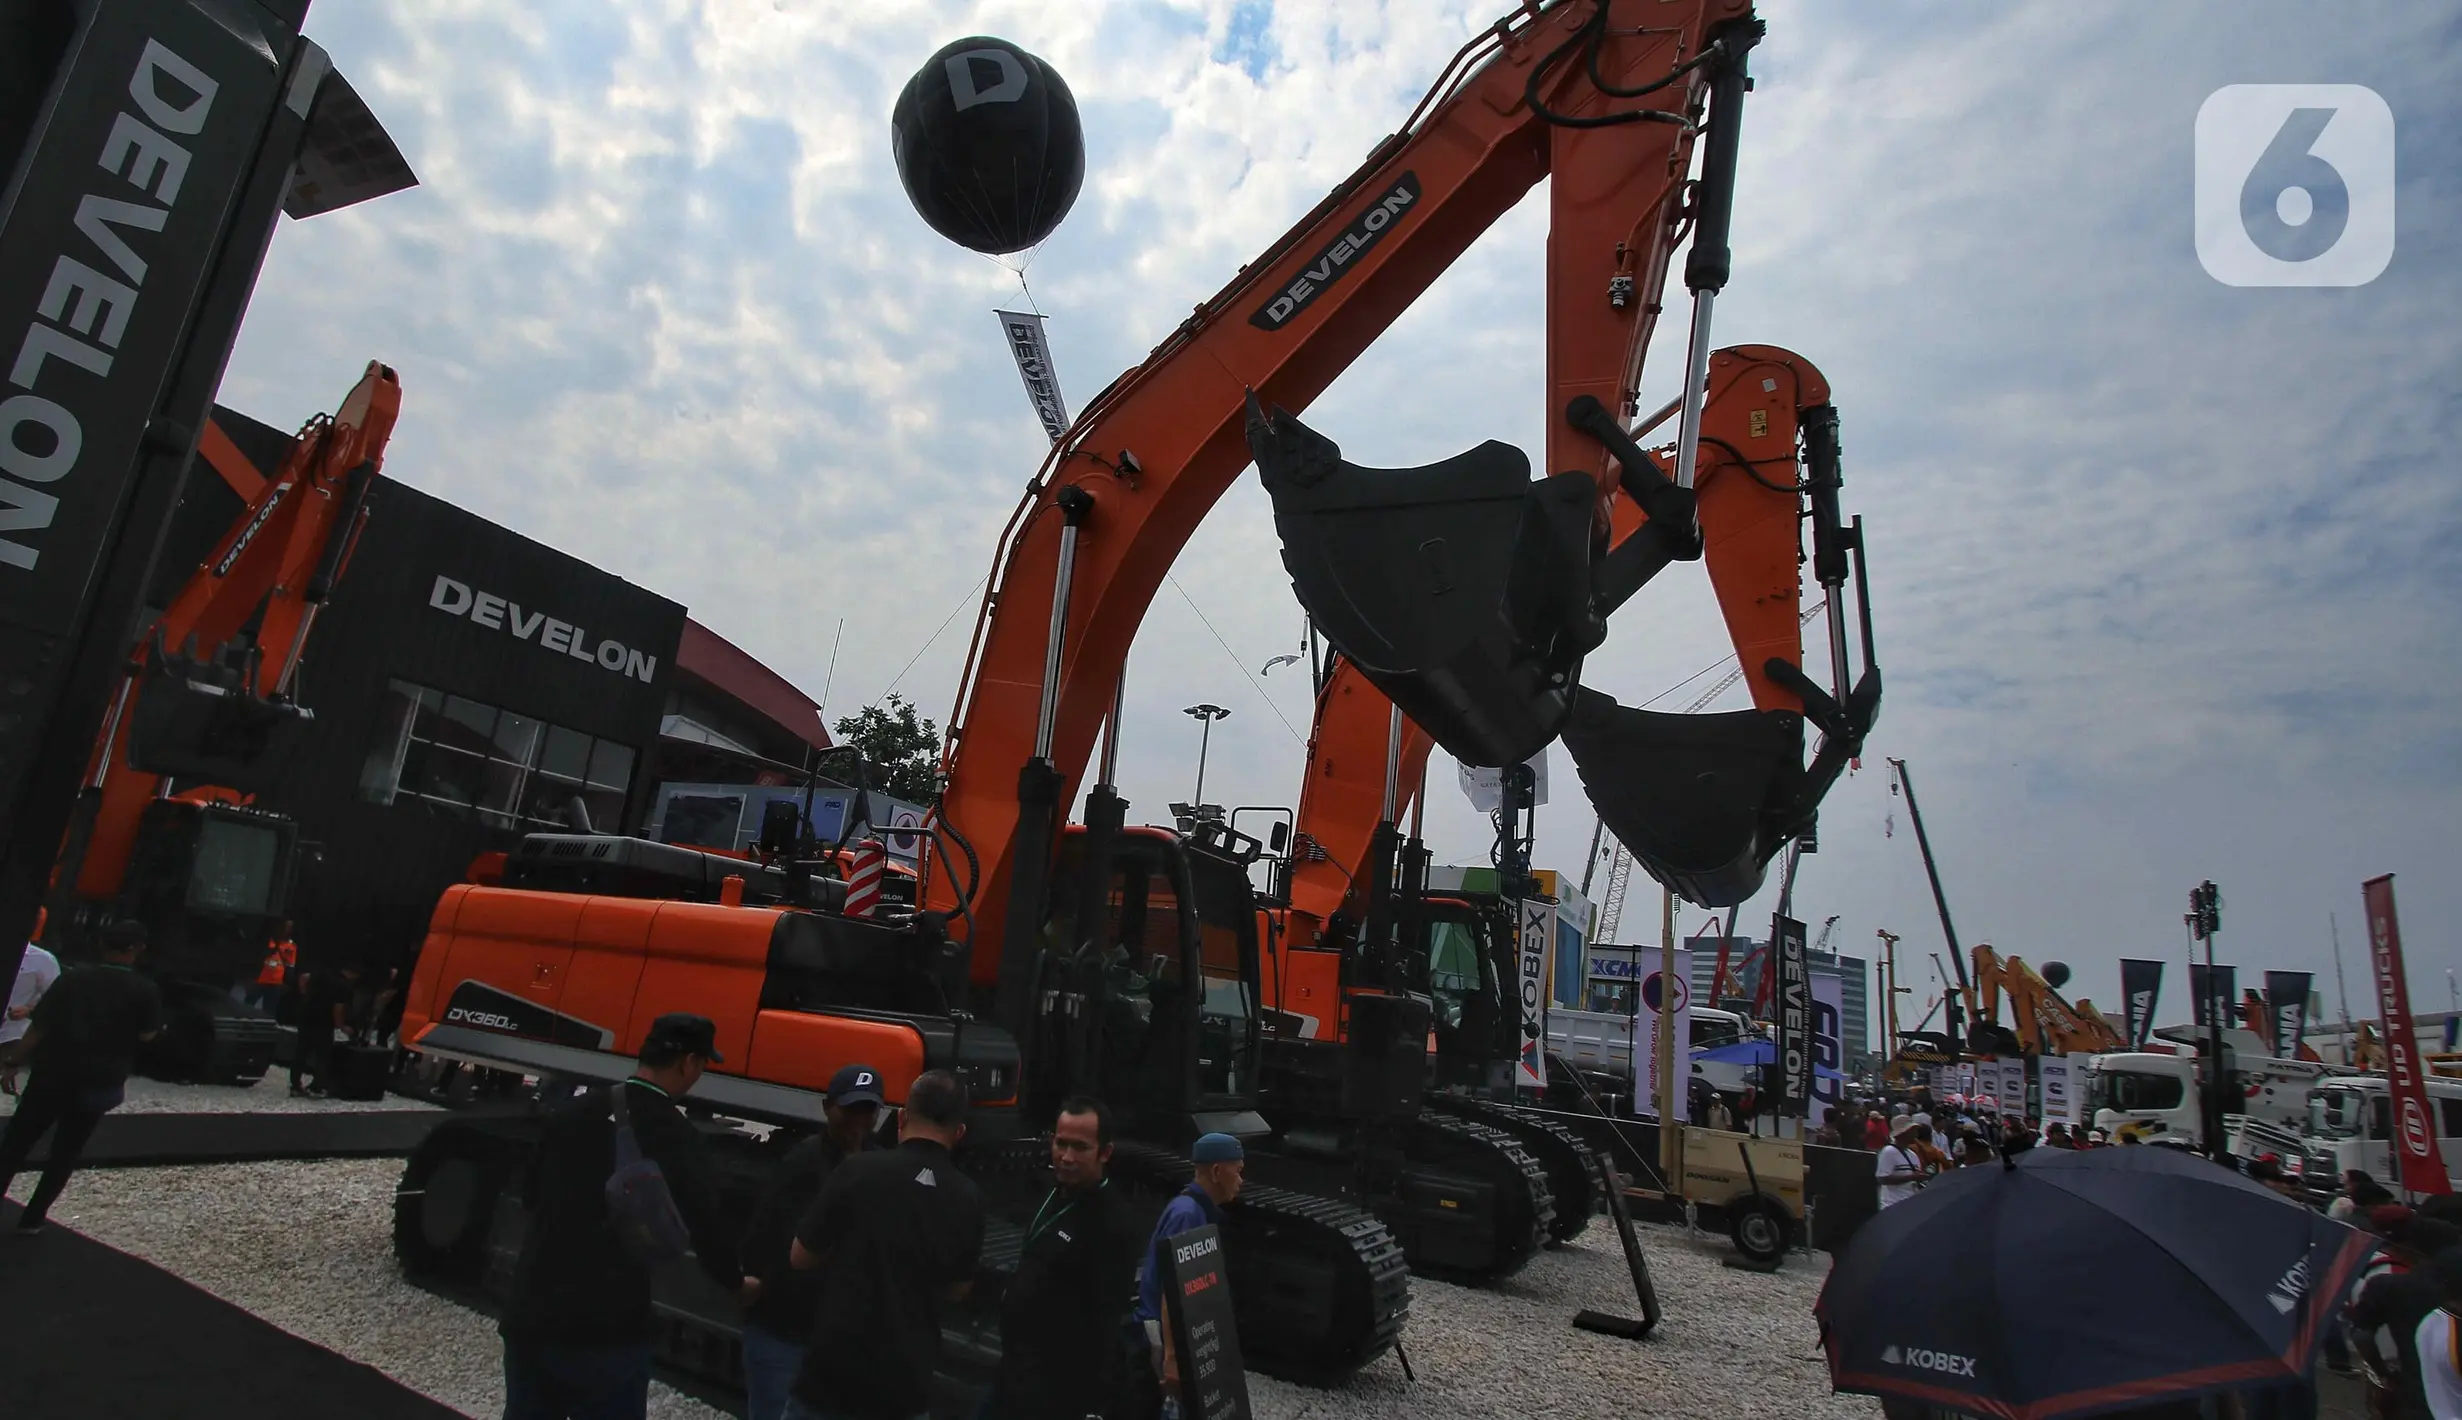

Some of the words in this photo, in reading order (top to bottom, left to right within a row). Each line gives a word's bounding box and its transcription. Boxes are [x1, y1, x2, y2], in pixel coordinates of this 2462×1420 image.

[945, 48, 1028, 112] D
[1266, 185, 1414, 325] DEVELON
[218, 495, 281, 574] DEVELON
[428, 574, 656, 684] DEVELON
[2374, 917, 2402, 1036] TRUCKS
[1784, 935, 1804, 1098] DEVELON
[2043, 998, 2075, 1033] CASE
[855, 1072, 874, 1086] D
[2391, 1044, 2412, 1086] UD
[1176, 1237, 1218, 1264] DEVELON
[1905, 1347, 1977, 1378] KOBEX
